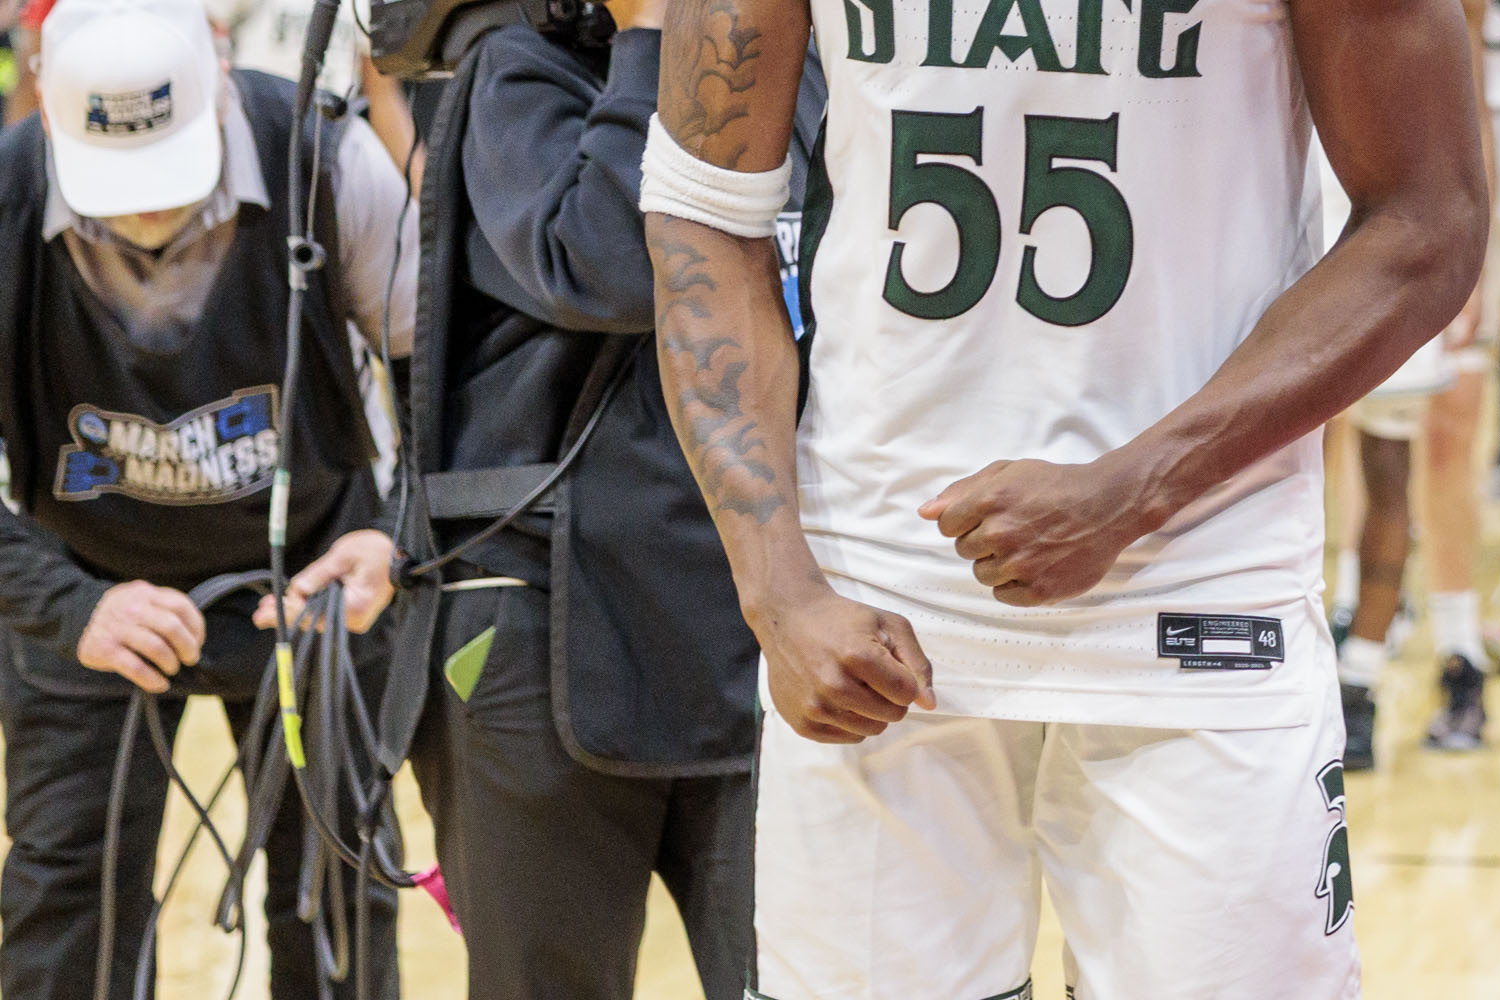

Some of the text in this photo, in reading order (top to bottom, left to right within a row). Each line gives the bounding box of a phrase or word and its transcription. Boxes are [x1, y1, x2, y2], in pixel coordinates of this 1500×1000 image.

[882, 105, 1134, 327] 55
[108, 413, 217, 460] MARCH
[125, 429, 281, 493] MADNESS
[1258, 630, 1276, 648] 48
